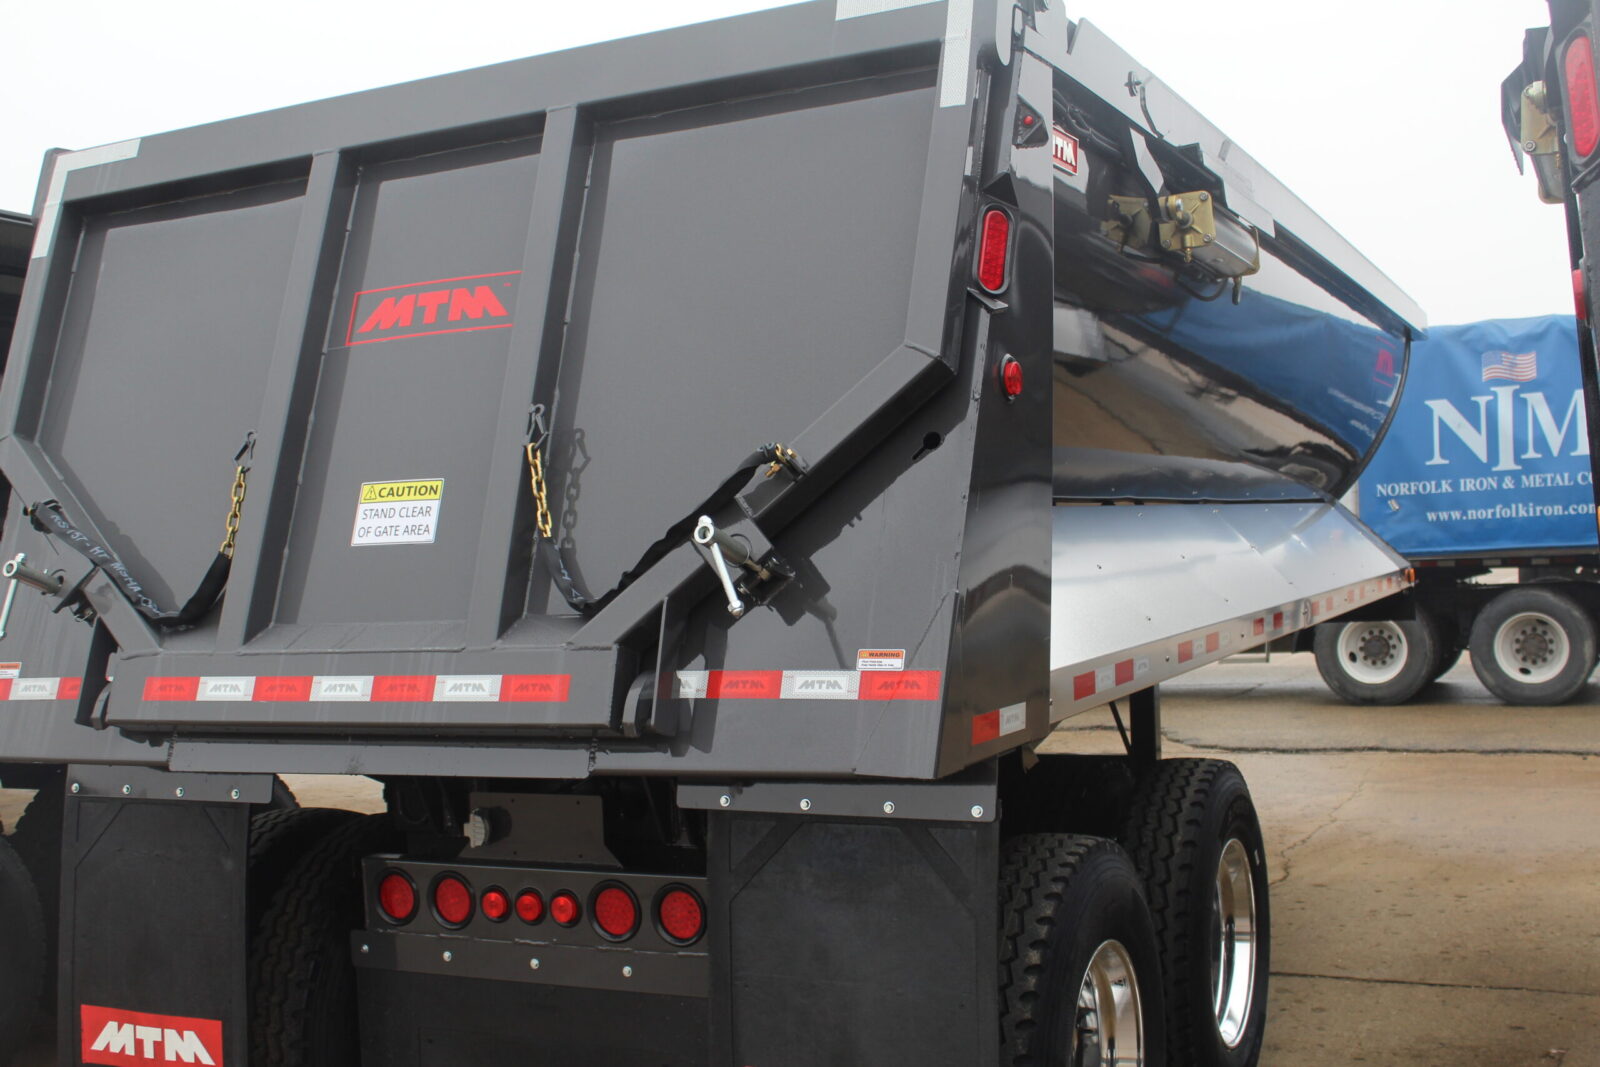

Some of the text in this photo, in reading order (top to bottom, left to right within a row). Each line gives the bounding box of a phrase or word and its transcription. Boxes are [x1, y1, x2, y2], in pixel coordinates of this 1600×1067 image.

[356, 286, 509, 333] MTM
[1424, 384, 1590, 471] NIM
[378, 484, 439, 498] CAUTION
[1376, 471, 1592, 497] NORFOLK IRON & METAL C
[362, 505, 432, 520] STAND CLEAR
[357, 524, 431, 538] OF GATE AREA
[208, 683, 242, 693] MTM
[323, 683, 359, 693] MTM
[447, 682, 486, 693] MTM
[797, 679, 843, 690] MTM
[90, 1020, 216, 1066] MTM
